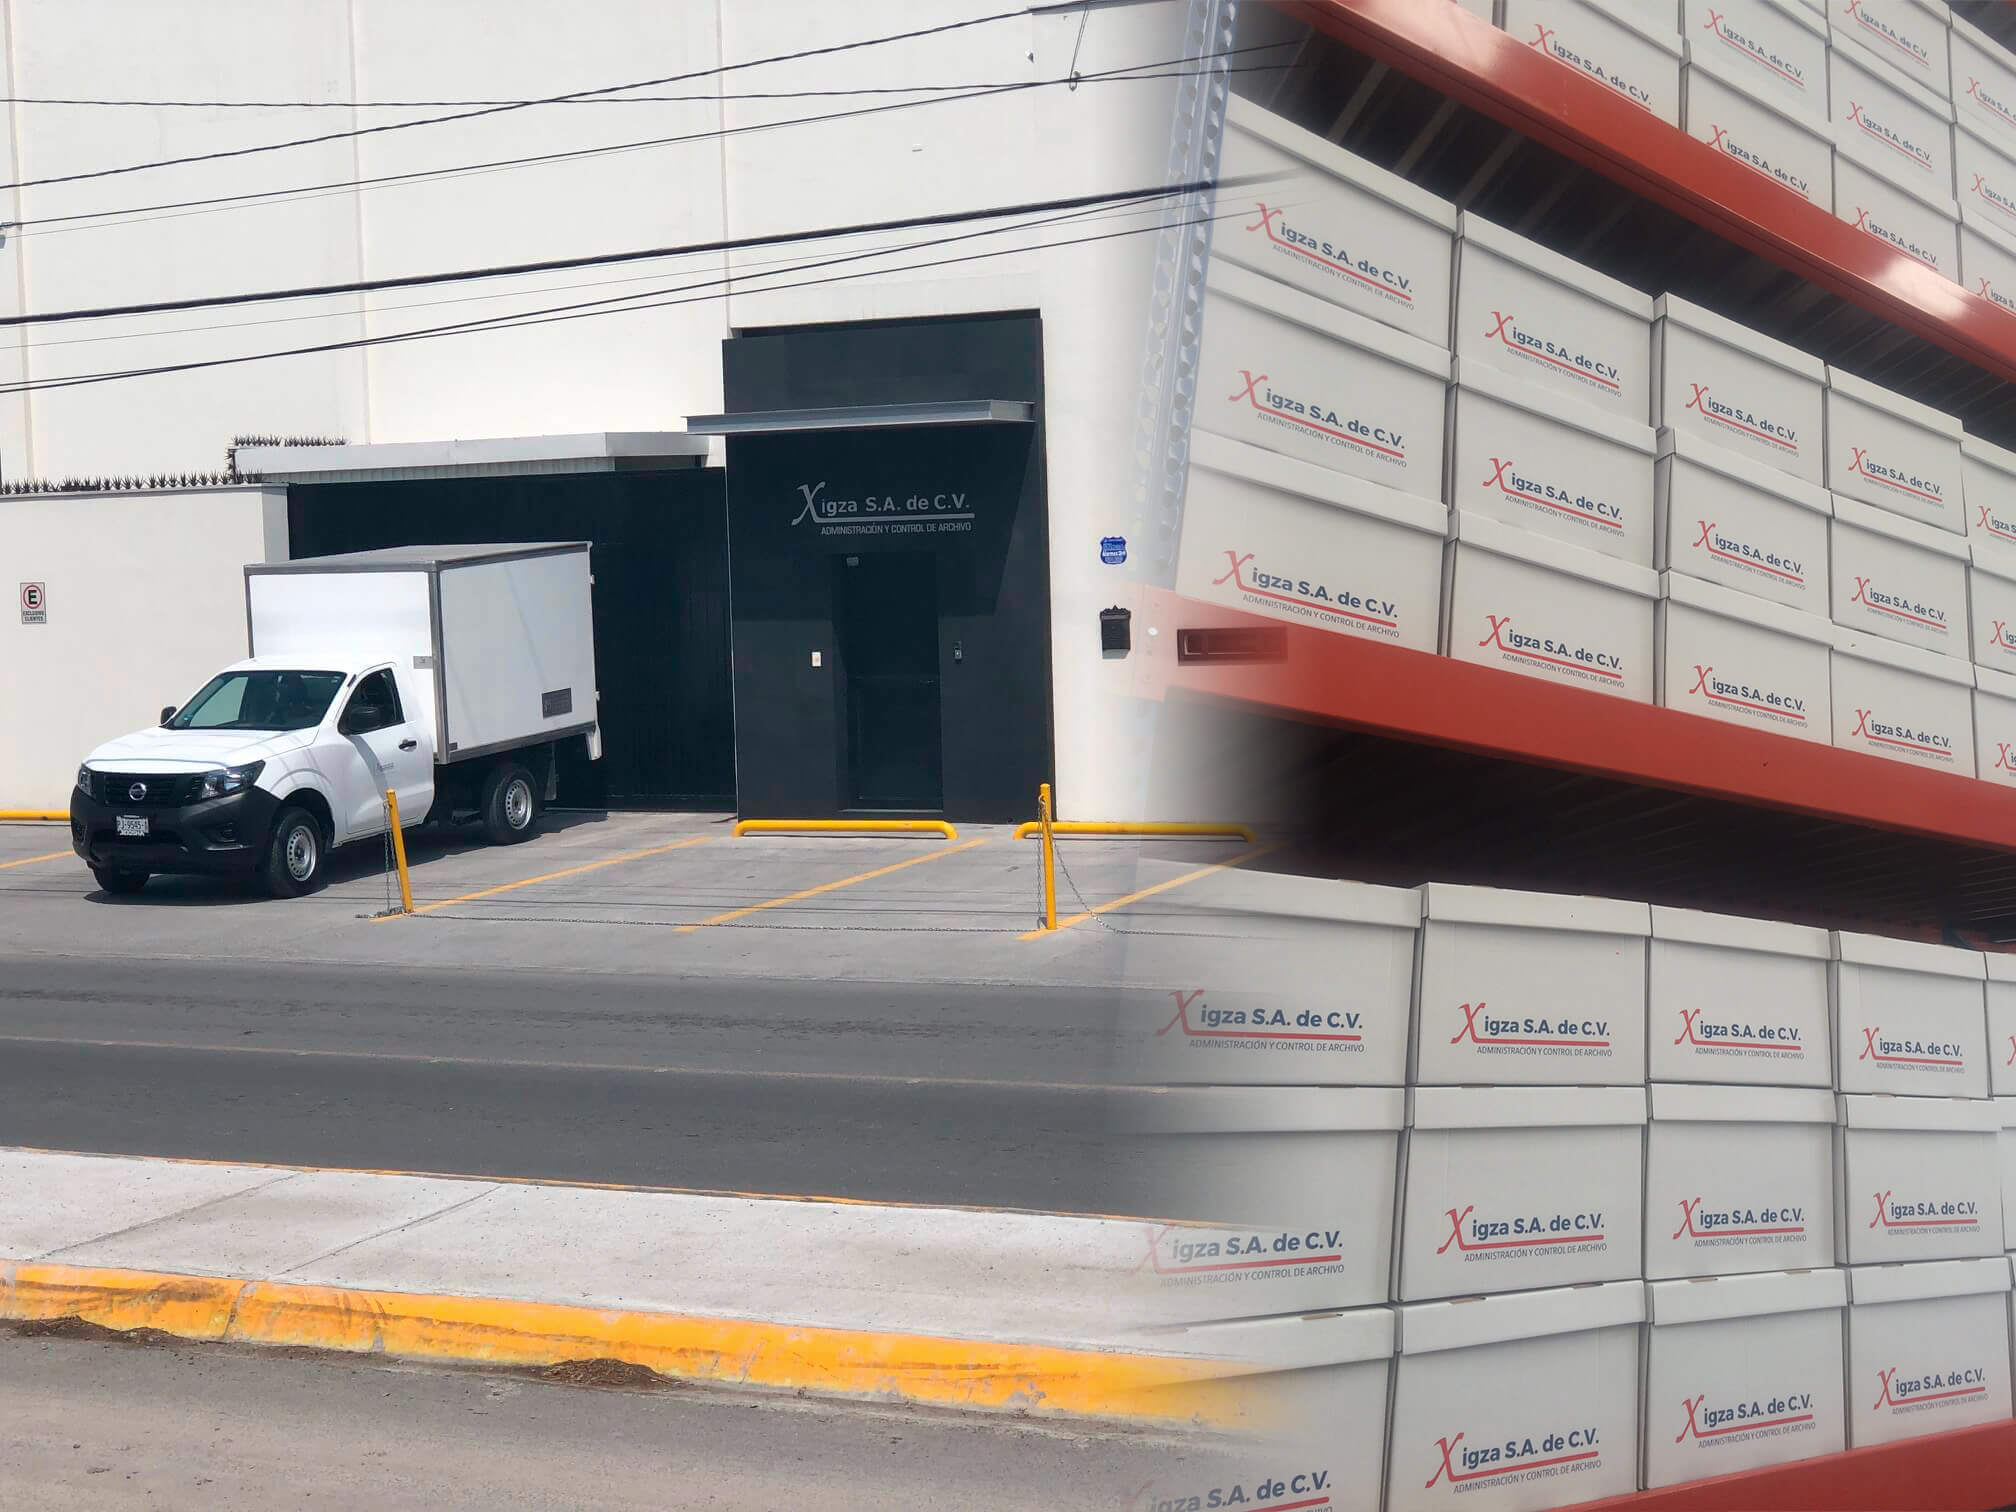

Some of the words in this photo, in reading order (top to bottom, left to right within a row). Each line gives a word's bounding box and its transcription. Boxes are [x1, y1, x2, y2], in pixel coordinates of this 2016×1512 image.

[1527, 24, 1581, 65] Xigza
[1584, 60, 1608, 81] S.A.
[1610, 77, 1626, 90] de
[1629, 87, 1651, 105] C.V.
[1702, 9, 1746, 46] Xigza
[1748, 40, 1768, 59] S.A.
[1770, 55, 1783, 67] de
[1785, 64, 1803, 80] C.V.
[1705, 125, 1750, 161] Xigza
[1752, 155, 1772, 173] S.A.
[1774, 169, 1788, 181] de
[1790, 177, 1808, 193] C.V.
[1245, 204, 1317, 250] Xigza
[1321, 243, 1354, 267] S.A.
[1357, 261, 1379, 277] de
[1382, 272, 1412, 293] C.V.
[1484, 312, 1542, 350] Xigza
[1545, 342, 1572, 362] S.A.
[1575, 355, 1592, 369] de
[1595, 364, 1620, 381] C.V.
[1228, 371, 1305, 414] Xigza
[1309, 405, 1343, 428] S.A.
[1347, 420, 1370, 436] de
[1374, 429, 1405, 449] C.V.
[1685, 384, 1733, 417] Xigza
[1735, 409, 1757, 427] S.A.
[1760, 420, 1774, 433] de
[1777, 427, 1797, 443] C.V.
[1257, 412, 1323, 440] ADMINISTRACIÓN
[1331, 438, 1364, 454] CONTROL
[1365, 448, 1376, 458] DE
[1375, 453, 1407, 468] ARCHIVO
[1482, 459, 1542, 494] Xigza
[1545, 486, 1573, 505] S.A.
[1576, 496, 1594, 510] de
[1597, 504, 1622, 521] C.V.
[1848, 448, 1888, 476] Xigza
[1889, 468, 1908, 484] S.A.
[1910, 476, 1922, 488] de
[1924, 482, 1942, 496] C.V.
[792, 481, 857, 526] Xigza
[865, 496, 900, 512] S.A.
[906, 495, 929, 511] de
[934, 493, 970, 510] C.V.
[821, 522, 883, 536] ADMINISTRACIÓN
[884, 525, 890, 533] Y
[891, 523, 924, 534] CONTROL
[926, 523, 937, 532] DE
[938, 521, 972, 532] ARCHIVO
[1692, 521, 1740, 553] Xigza
[1742, 545, 1764, 562] S.A.
[1766, 554, 1781, 566] de
[1783, 560, 1803, 575] C.V.
[28, 589, 37, 604] E
[1212, 551, 1293, 592] Xigza
[1298, 581, 1333, 602] S.A.
[1337, 592, 1361, 608] de
[1365, 599, 1398, 618] C.V.
[1851, 577, 1891, 605] Xigza
[1893, 597, 1912, 611] S.A.
[1914, 604, 1926, 615] de
[1928, 609, 1946, 622] C.V.
[1478, 615, 1540, 650] Xigza
[1544, 640, 1572, 658] S.A.
[1575, 648, 1593, 662] de
[1596, 654, 1622, 670] C.V.
[1688, 665, 1738, 695] Xigza
[1741, 686, 1764, 702] S.A.
[1766, 693, 1781, 705] de
[1784, 698, 1805, 712] C.V.
[1851, 709, 1894, 736] Xigza
[1895, 727, 1915, 741] S.A.
[1917, 732, 1931, 743] de
[1932, 735, 1951, 748] C.V.
[1154, 989, 1246, 1036] Xigza
[1252, 1009, 1291, 1026] S.A.
[1296, 1010, 1322, 1027] de
[1327, 1013, 1363, 1029] C.V.
[1450, 1002, 1519, 1044] Xigza
[1523, 1019, 1554, 1034] S.A.
[1558, 1020, 1578, 1035] de
[1581, 1022, 1610, 1036] C.V.
[1674, 1008, 1728, 1045] Xigza
[1730, 1024, 1756, 1038] S.A.
[1758, 1025, 1775, 1039] de
[1778, 1028, 1801, 1041] C.V.
[1188, 1039, 1267, 1049] ADMINISTRACIÓN
[1269, 1042, 1278, 1050] Y
[1276, 1042, 1315, 1051] CONTROL
[1316, 1043, 1328, 1052] DE
[1328, 1044, 1365, 1053] ARCHIVO
[1477, 1046, 1536, 1055] ADMINISTRACIÓN
[1543, 1048, 1573, 1056] CONTROL
[1583, 1049, 1612, 1057] ARCHIVO
[1859, 1027, 1903, 1060] Xigza
[1904, 1041, 1925, 1054] S.A.
[1927, 1042, 1941, 1055] de
[1943, 1044, 1962, 1057] C.V.
[1436, 1205, 1509, 1255] Xigza
[1513, 1217, 1546, 1234] S.A.
[1549, 1215, 1571, 1232] de
[1575, 1213, 1604, 1230] C.V.
[1672, 1197, 1729, 1240] Xigza
[1732, 1210, 1758, 1224] S.A.
[1760, 1208, 1777, 1223] de
[1780, 1208, 1804, 1222] C.V.
[1869, 1190, 1915, 1228] Xigza
[1917, 1202, 1939, 1215] S.A.
[1941, 1202, 1955, 1215] de
[1957, 1202, 1978, 1214] C.V.
[1226, 1236, 1267, 1255] S.A.
[1273, 1233, 1300, 1252] de
[1305, 1231, 1343, 1249] C.V.
[1464, 1248, 1527, 1262] ADMINISTRACIÓN
[1529, 1248, 1536, 1257] Y
[1534, 1246, 1566, 1256] CONTROL
[1567, 1245, 1577, 1254] DE
[1577, 1244, 1607, 1253] ARCHIVO
[1694, 1237, 1744, 1247] ADMINISTRACIÓN
[1744, 1237, 1750, 1245] Y
[1749, 1236, 1774, 1244] CONTROL
[1775, 1235, 1783, 1243] DE
[1783, 1235, 1807, 1243] ARCHIVO
[1873, 1367, 1921, 1410] Xigza
[1923, 1374, 1946, 1389] S.A.
[1947, 1371, 1962, 1386] de
[1964, 1368, 1985, 1383] C.V.
[1675, 1394, 1734, 1443] Xigza
[1737, 1401, 1764, 1419] S.A.
[1767, 1398, 1785, 1414] de
[1788, 1393, 1813, 1411] C.V.
[1425, 1432, 1500, 1489] Xigza
[1505, 1438, 1538, 1458] S.A.
[1542, 1434, 1564, 1453] de
[1568, 1428, 1599, 1448] C.V.
[1453, 1474, 1519, 1494] ADMINISTRACIÓN
[1520, 1472, 1528, 1482] Y
[1526, 1467, 1559, 1480] CONTROL
[1560, 1464, 1570, 1475] DE
[1570, 1460, 1602, 1473] ARCHIVO
[1207, 1485, 1250, 1508] S.A.
[1257, 1479, 1285, 1499] de
[1291, 1471, 1331, 1493] C.V.
